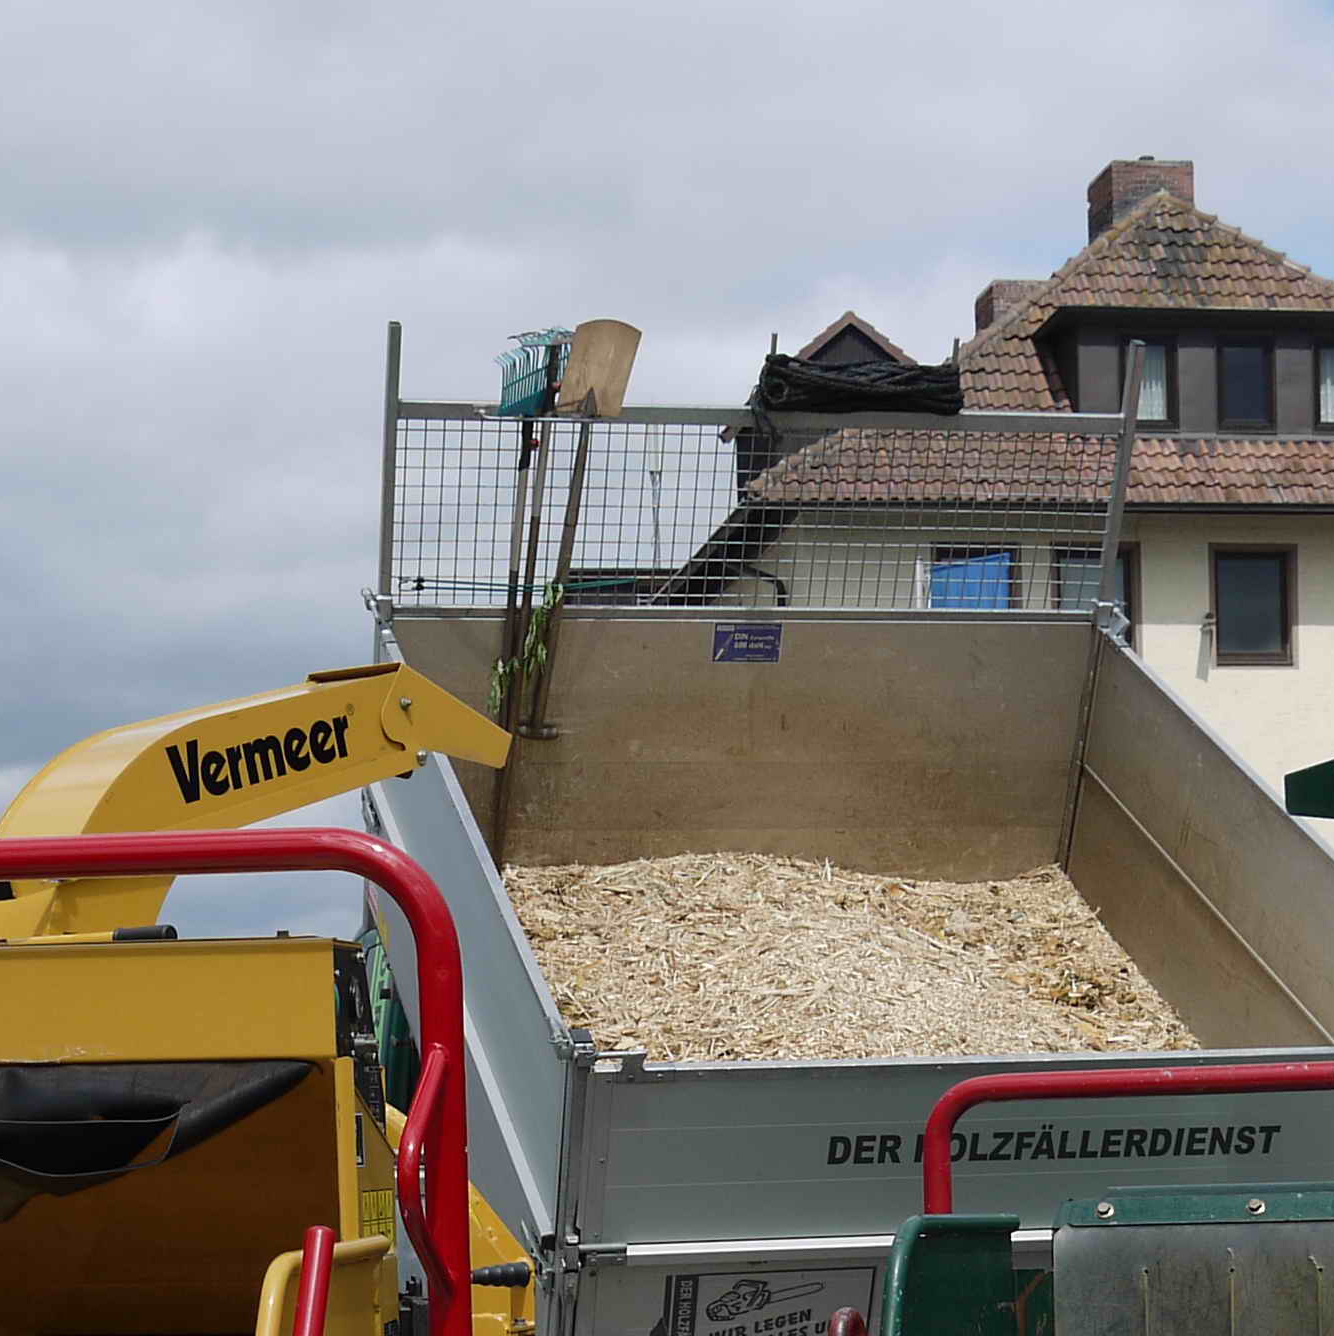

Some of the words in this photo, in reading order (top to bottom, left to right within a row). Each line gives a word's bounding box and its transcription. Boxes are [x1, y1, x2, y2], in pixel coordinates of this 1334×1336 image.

[166, 714, 348, 804] Vermeer
[827, 1135, 901, 1165] DER
[679, 1280, 693, 1300] DER
[754, 1308, 812, 1334] LEGEN
[814, 1321, 827, 1335] U
